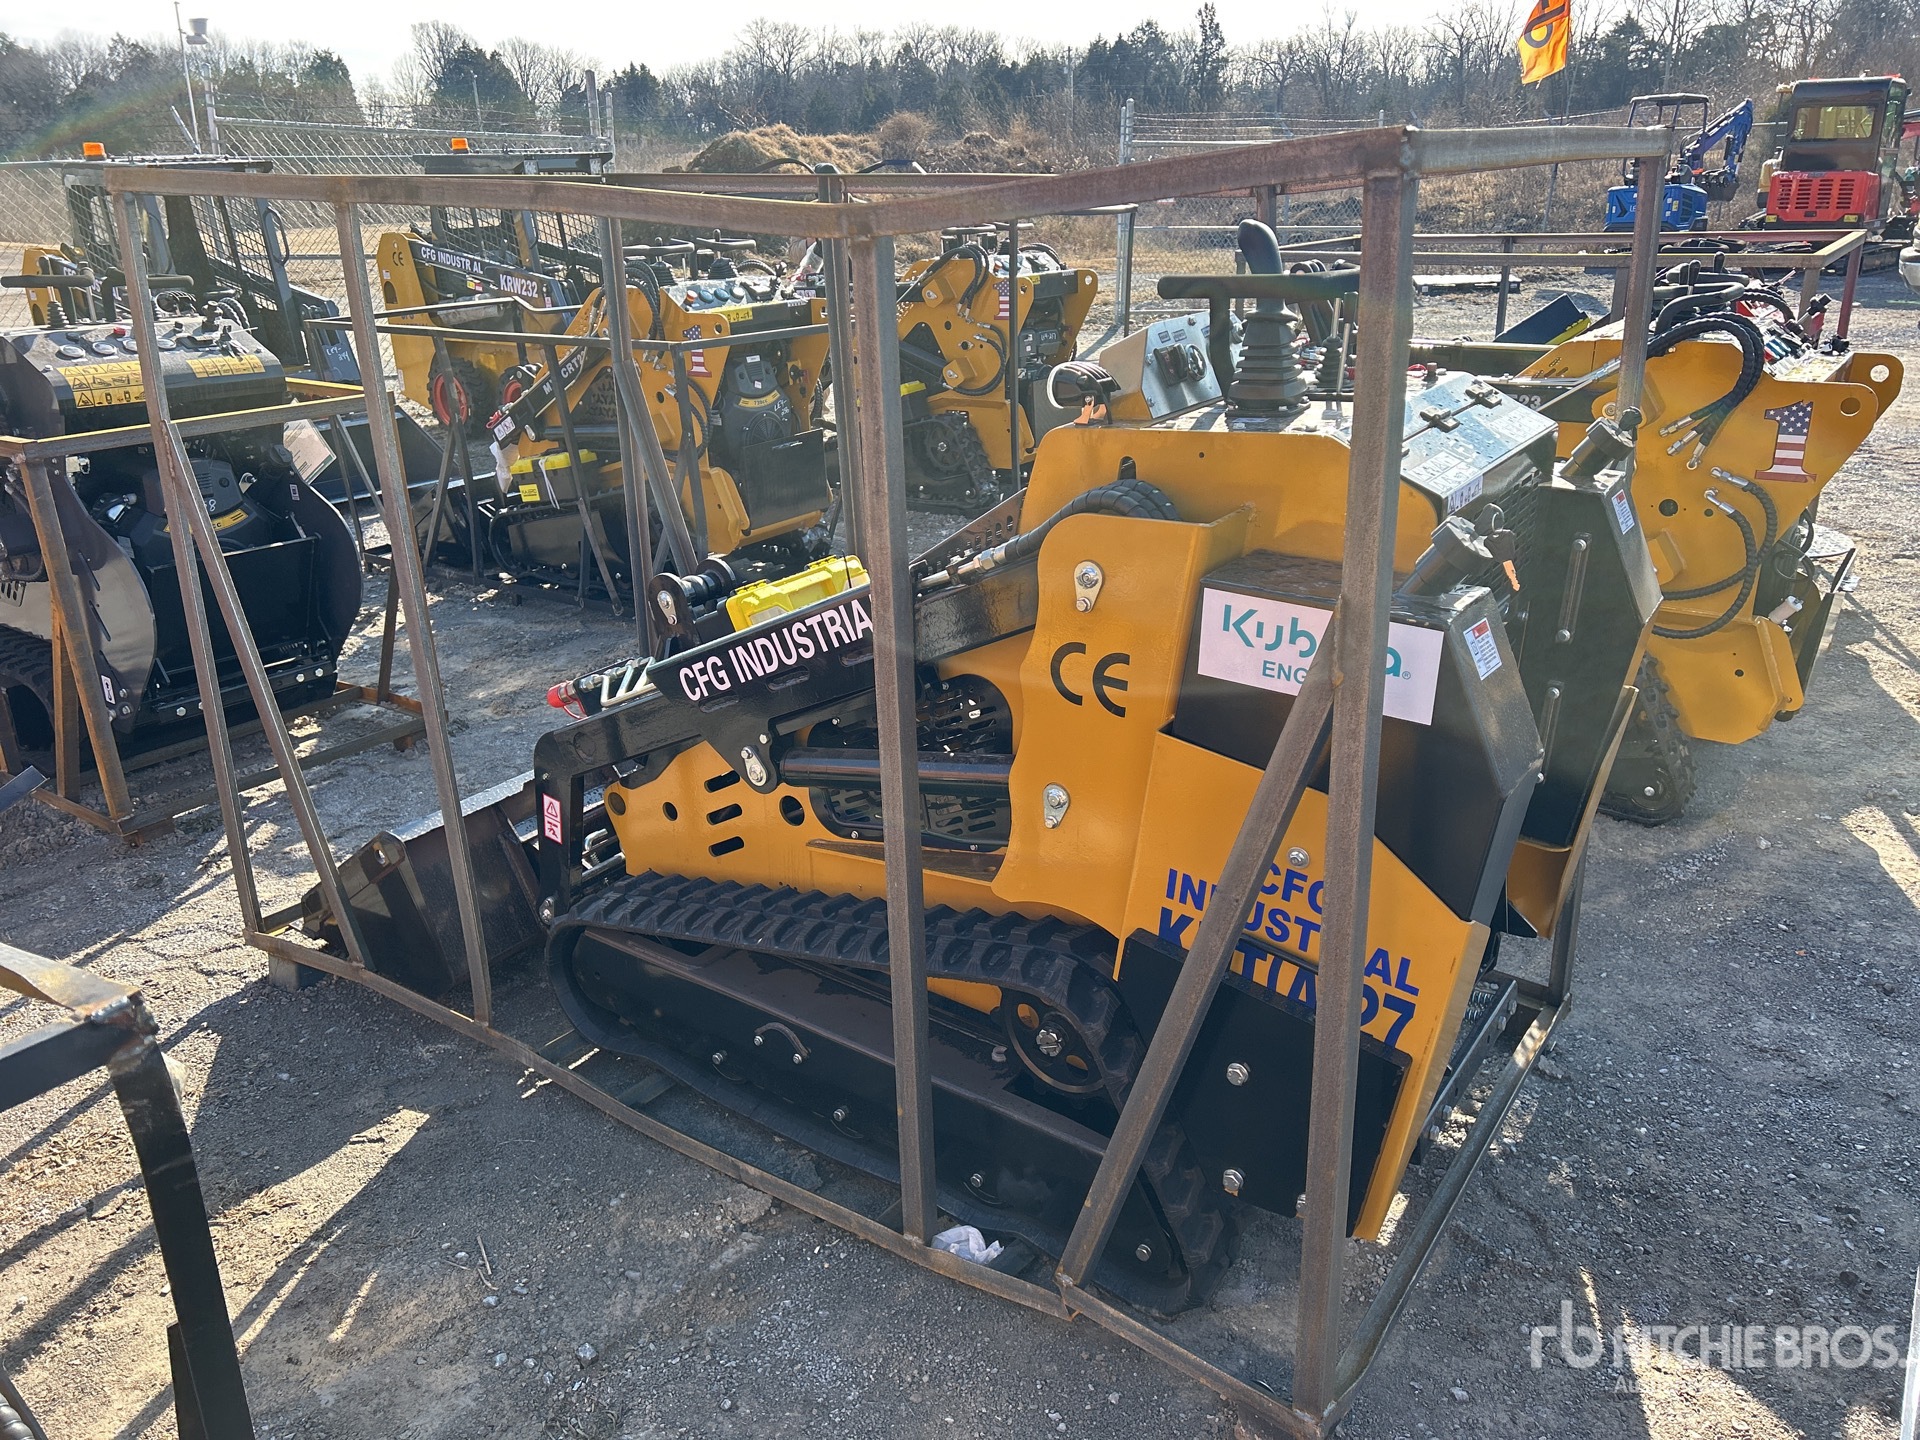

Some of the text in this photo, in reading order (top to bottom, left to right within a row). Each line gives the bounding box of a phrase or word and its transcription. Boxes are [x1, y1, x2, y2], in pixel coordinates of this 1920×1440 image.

[421, 246, 436, 261] CFG
[499, 273, 539, 299] KRW232
[679, 597, 874, 701] CFG INDUSTRIA
[1222, 604, 1402, 678] Kuba
[1050, 641, 1131, 718] CE
